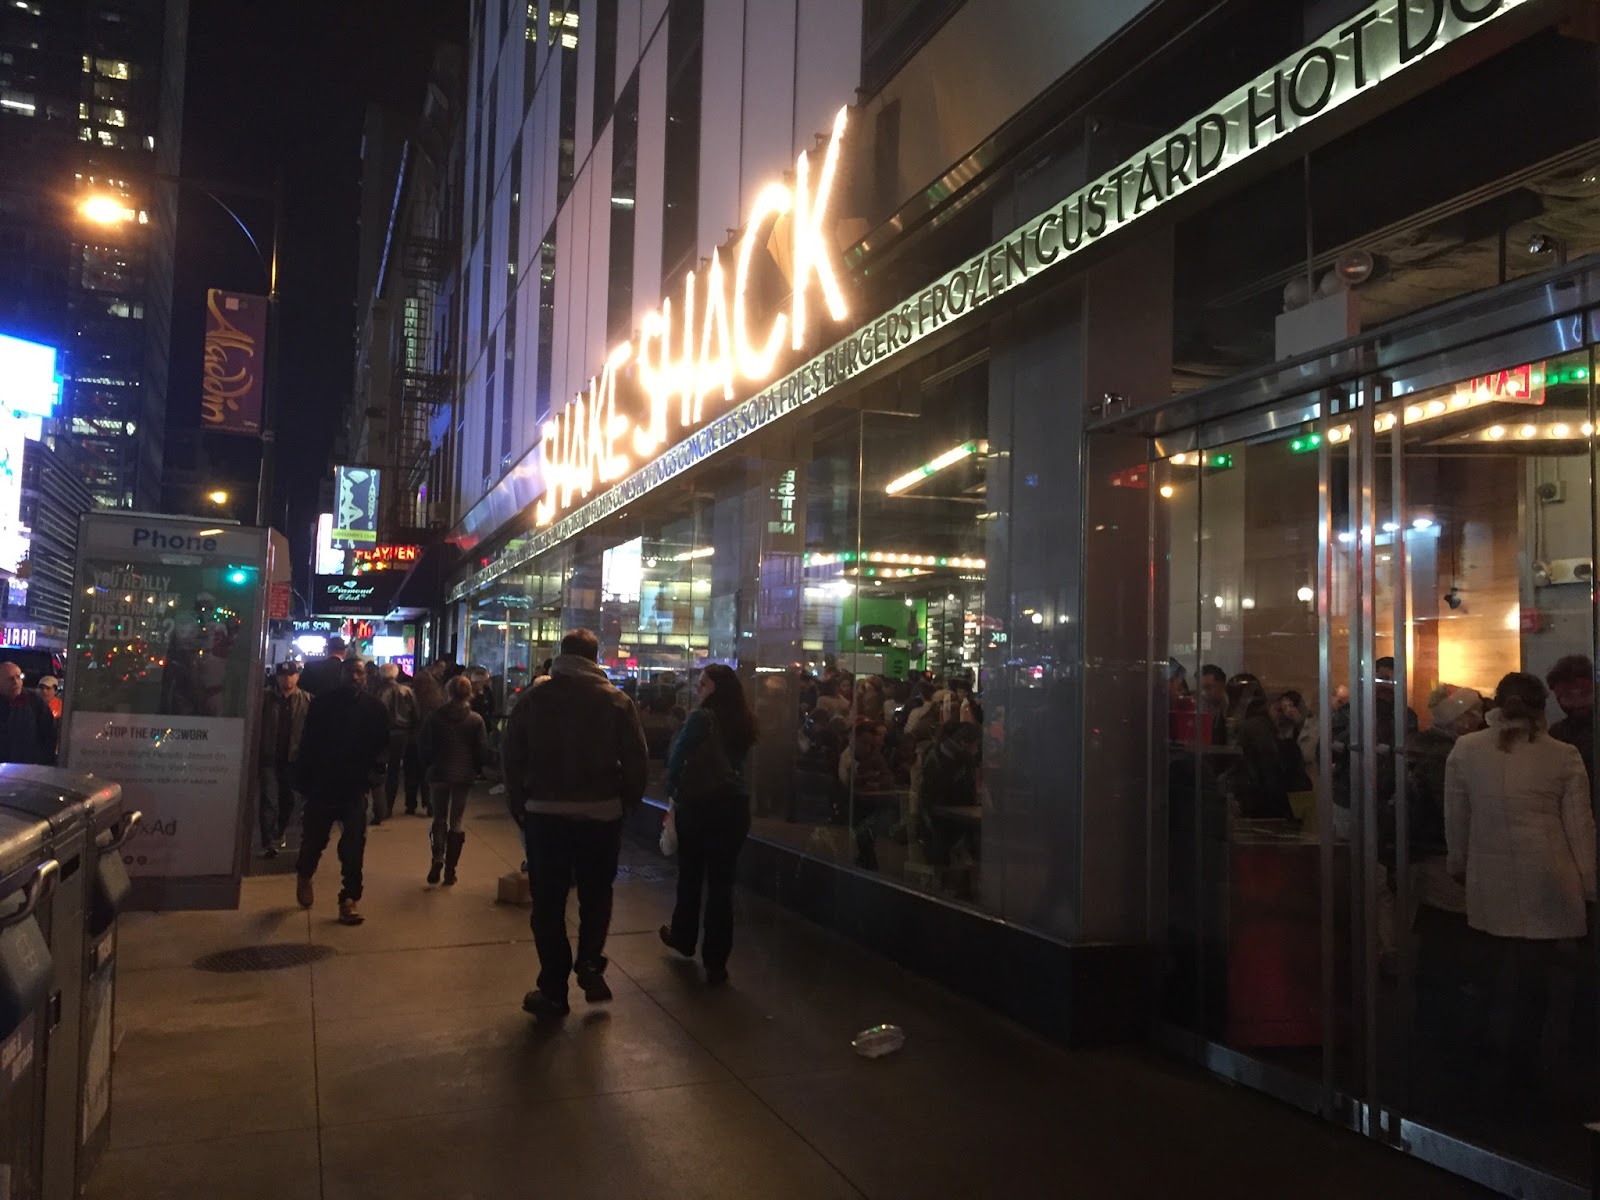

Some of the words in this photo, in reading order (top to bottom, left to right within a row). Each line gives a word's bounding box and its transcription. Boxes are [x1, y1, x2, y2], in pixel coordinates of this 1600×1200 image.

[677, 414, 739, 470] CONCRETES
[740, 389, 778, 434] SODA
[780, 360, 822, 412] FRIES
[824, 303, 913, 389] BURGERS
[918, 231, 1028, 334] FROZEN
[1035, 113, 1227, 264] CUSTARD
[1247, 11, 1380, 149] HOT
[537, 340, 633, 526] SHAKE
[634, 105, 849, 456] SHACK
[406, 299, 418, 378] LINGERI
[201, 287, 255, 424] Aladdin
[132, 528, 218, 552] Phone
[94, 571, 119, 588] YOU
[121, 573, 171, 592] REALLY
[327, 584, 375, 595] Diamond
[91, 599, 116, 614] THIS
[88, 613, 135, 641] RED
[101, 725, 128, 738] STOP
[131, 726, 148, 739] THE
[150, 727, 208, 741] GUSSWORK
